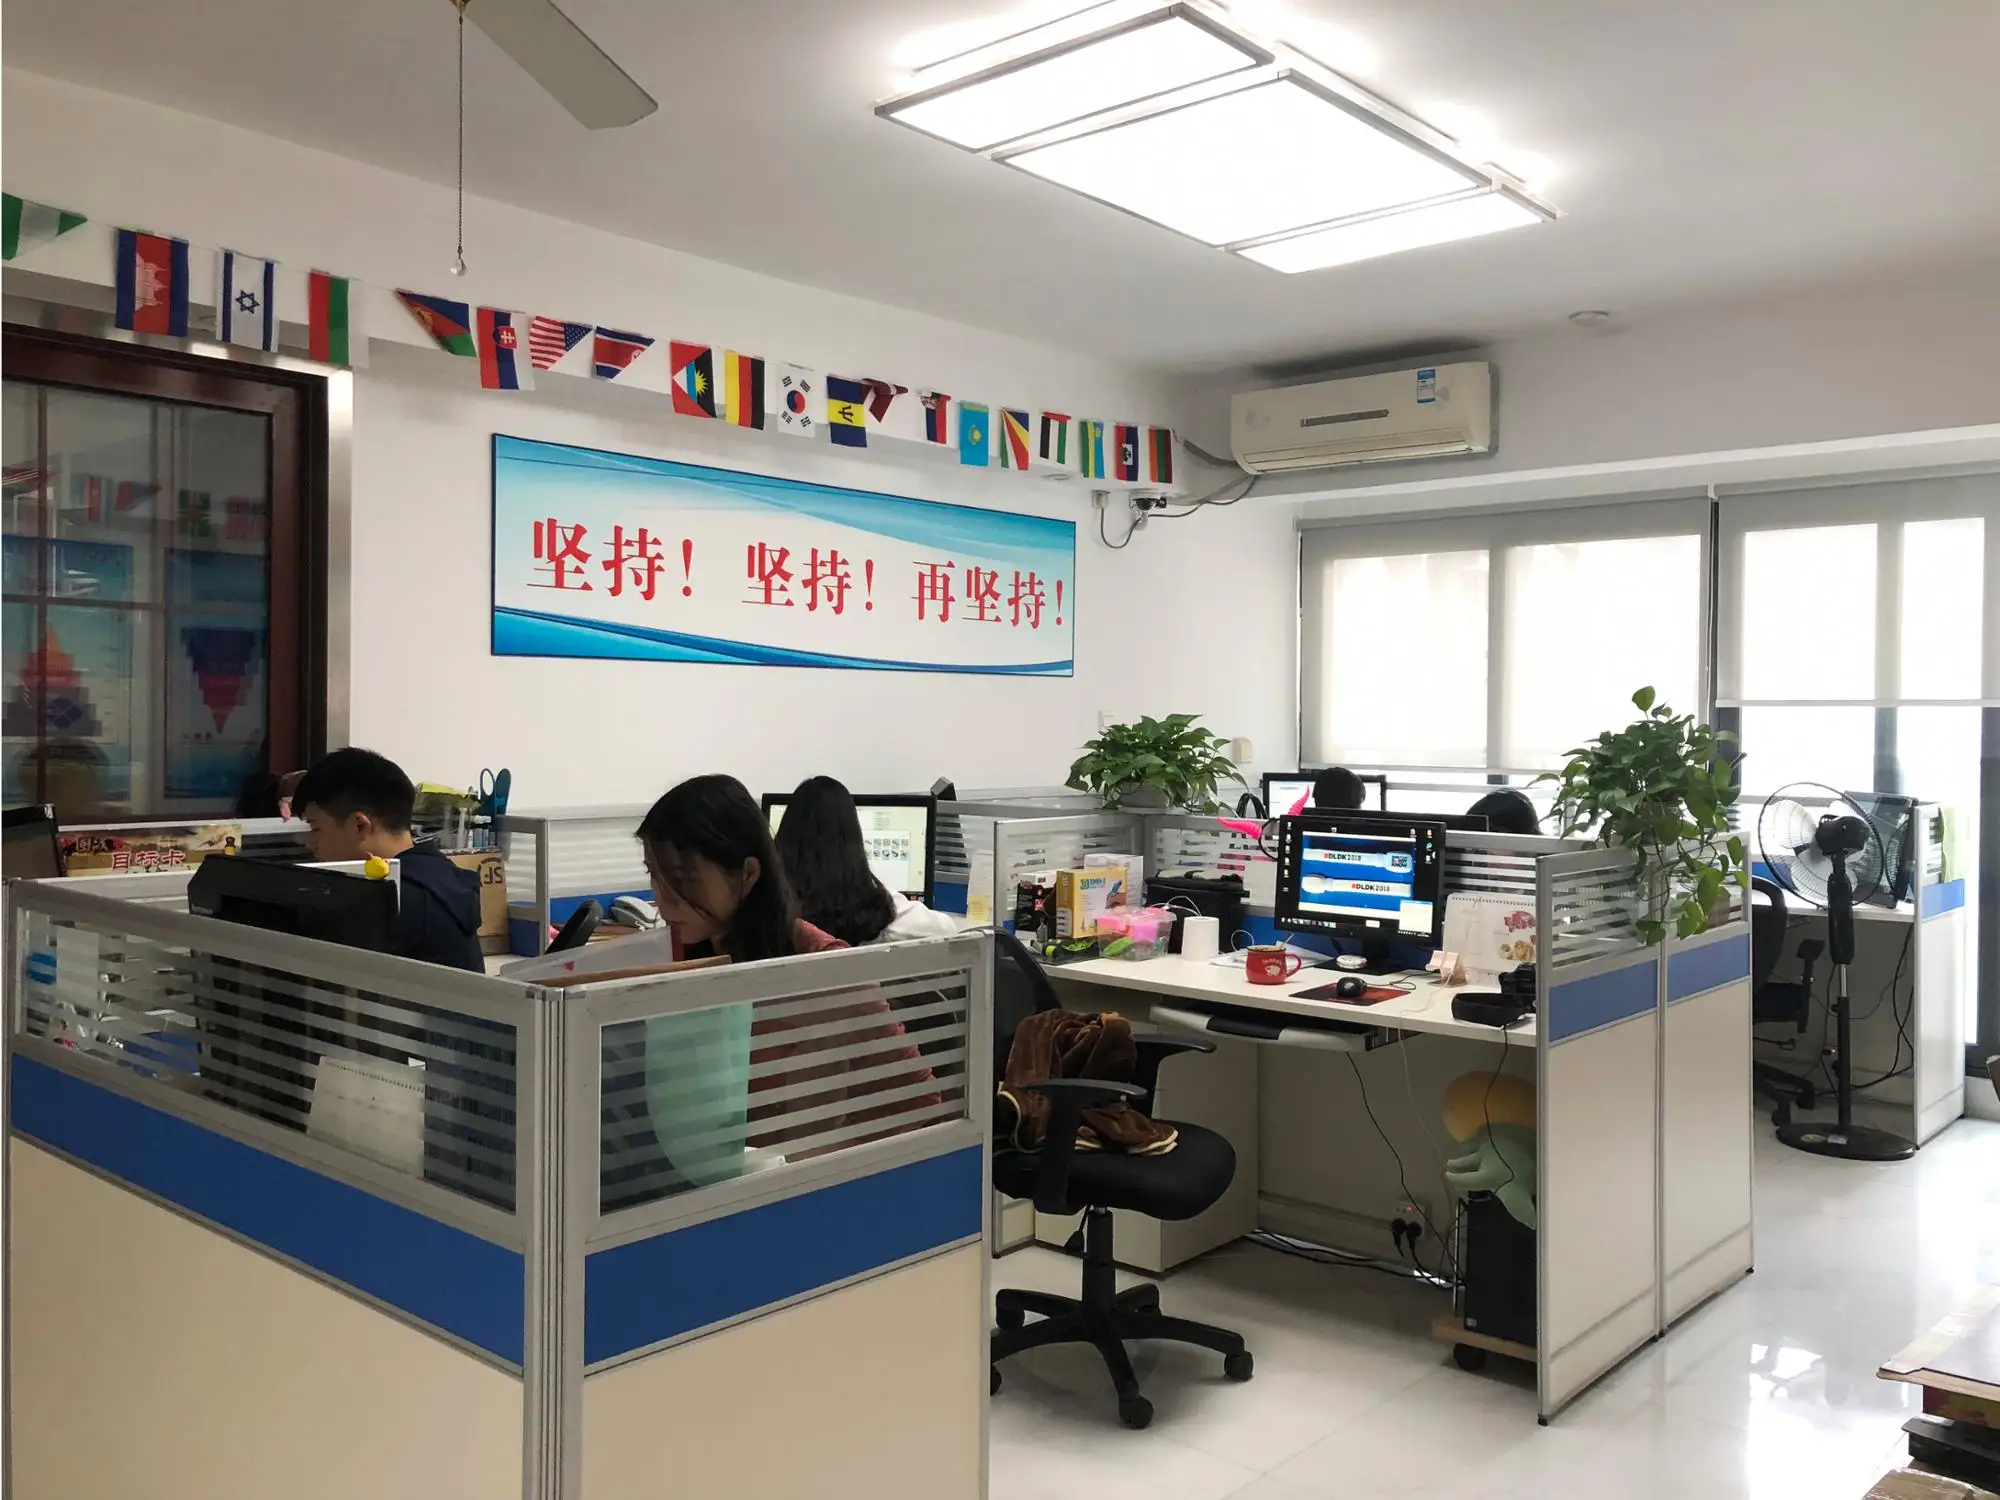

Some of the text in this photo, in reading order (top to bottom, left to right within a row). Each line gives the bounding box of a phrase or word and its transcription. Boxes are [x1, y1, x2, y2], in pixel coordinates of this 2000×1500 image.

[526, 517, 1063, 629] 坚持！ 坚持！ 再坚持！
[111, 848, 186, 871] 目标卡
